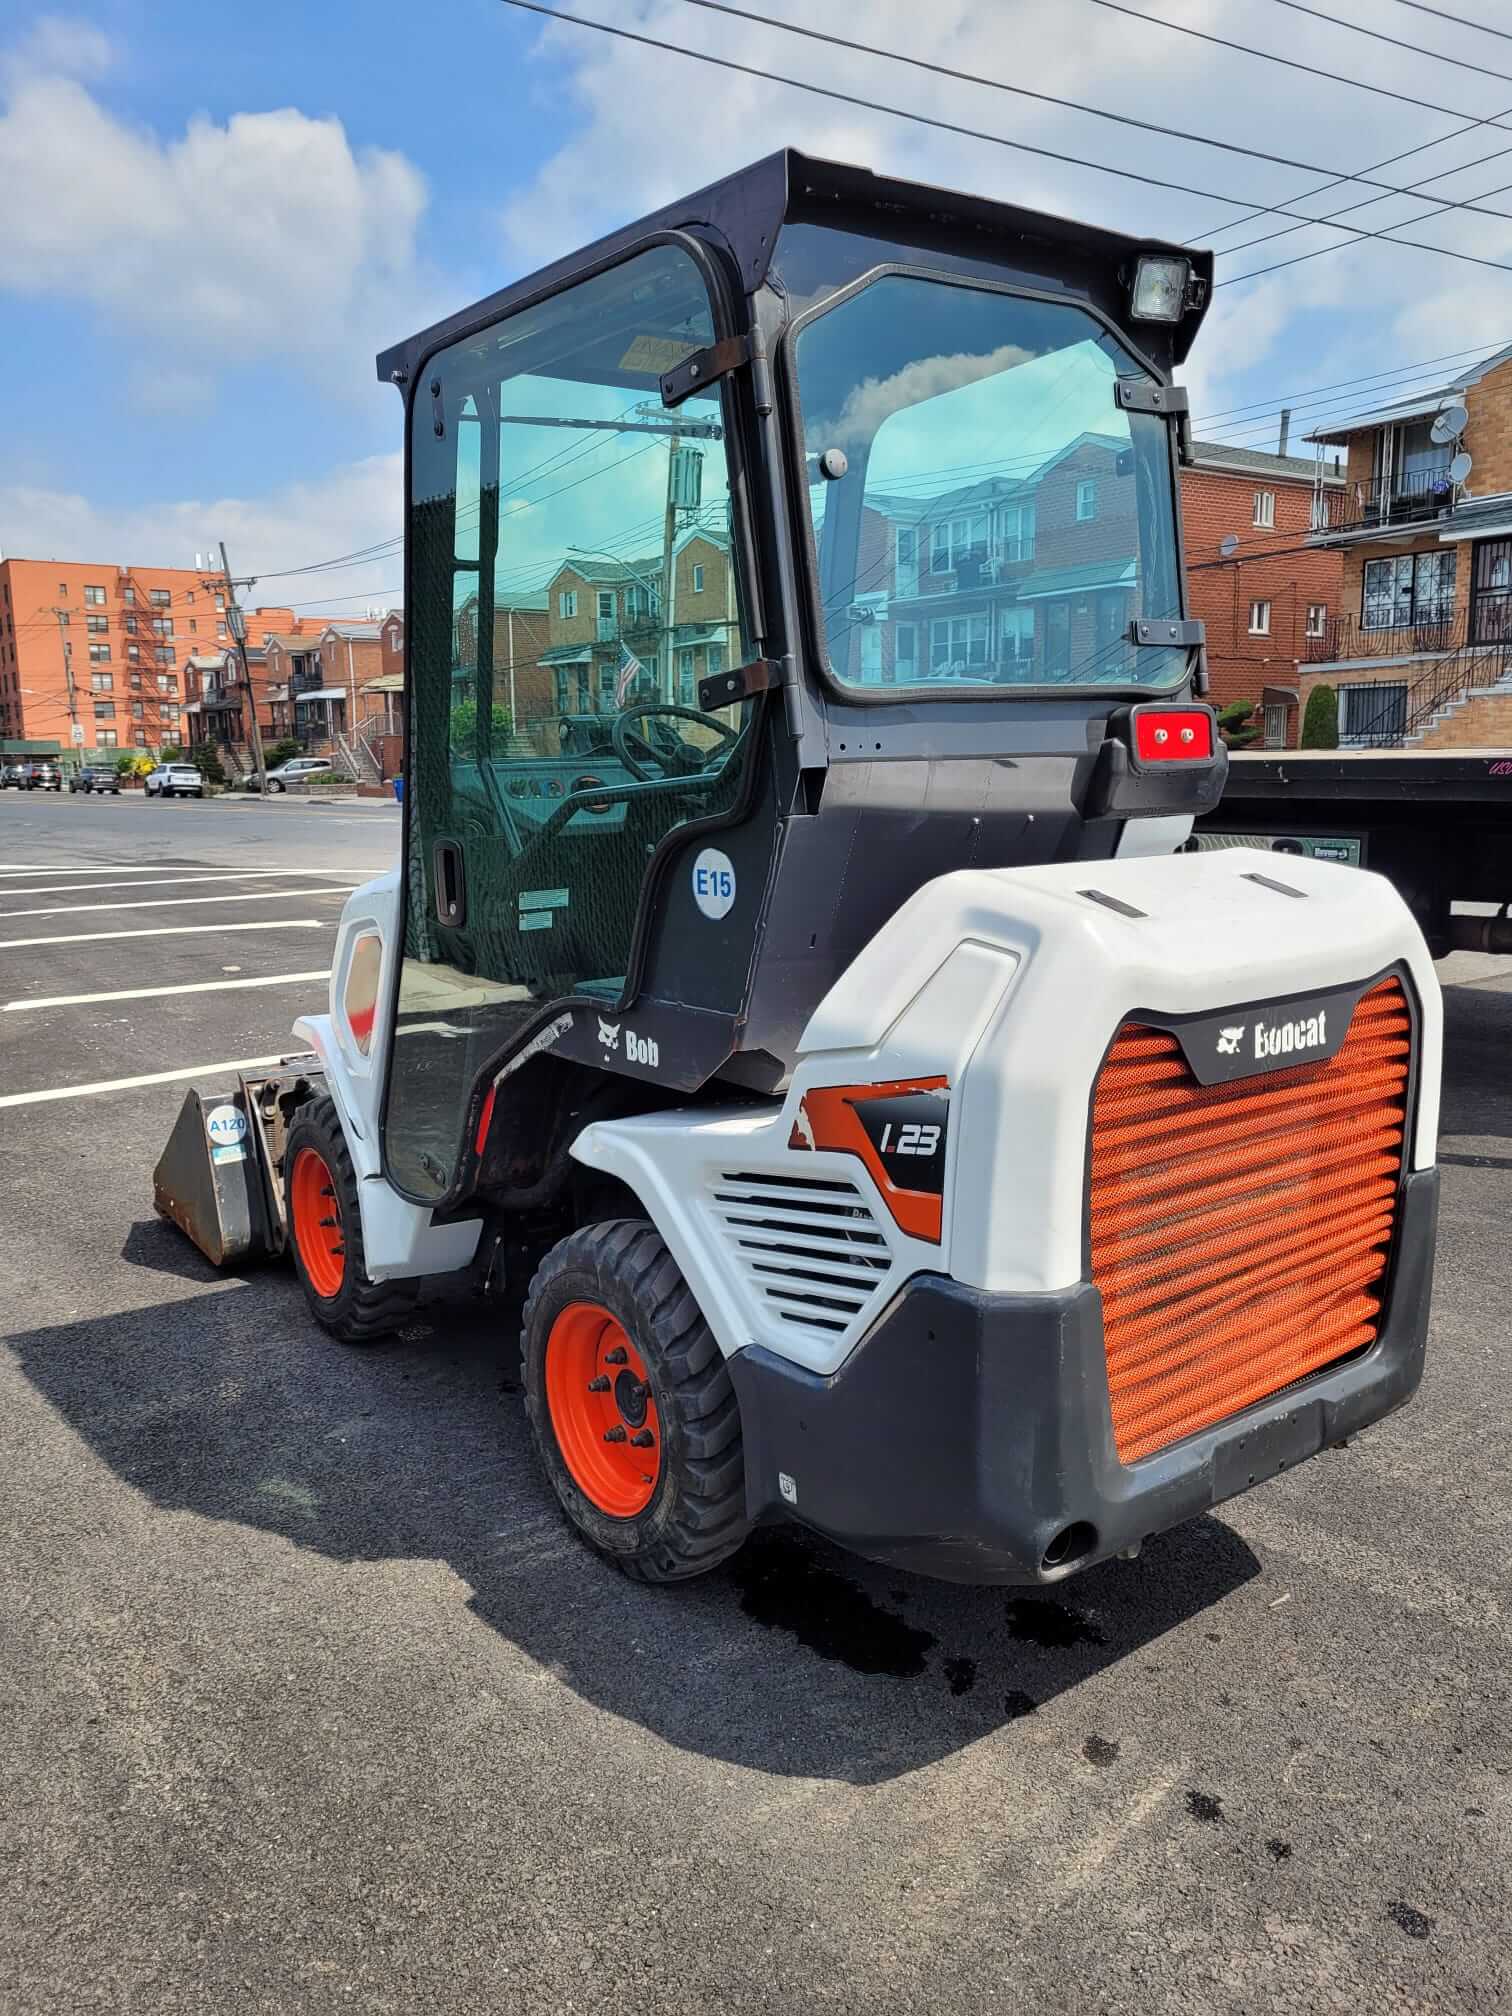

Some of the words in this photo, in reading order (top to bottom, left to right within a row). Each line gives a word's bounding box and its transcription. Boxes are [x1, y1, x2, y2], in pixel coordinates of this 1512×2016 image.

[696, 868, 731, 898] E15
[625, 1030, 659, 1067] Bob
[1254, 1010, 1327, 1059] Bobcat
[210, 1118, 245, 1132] A120
